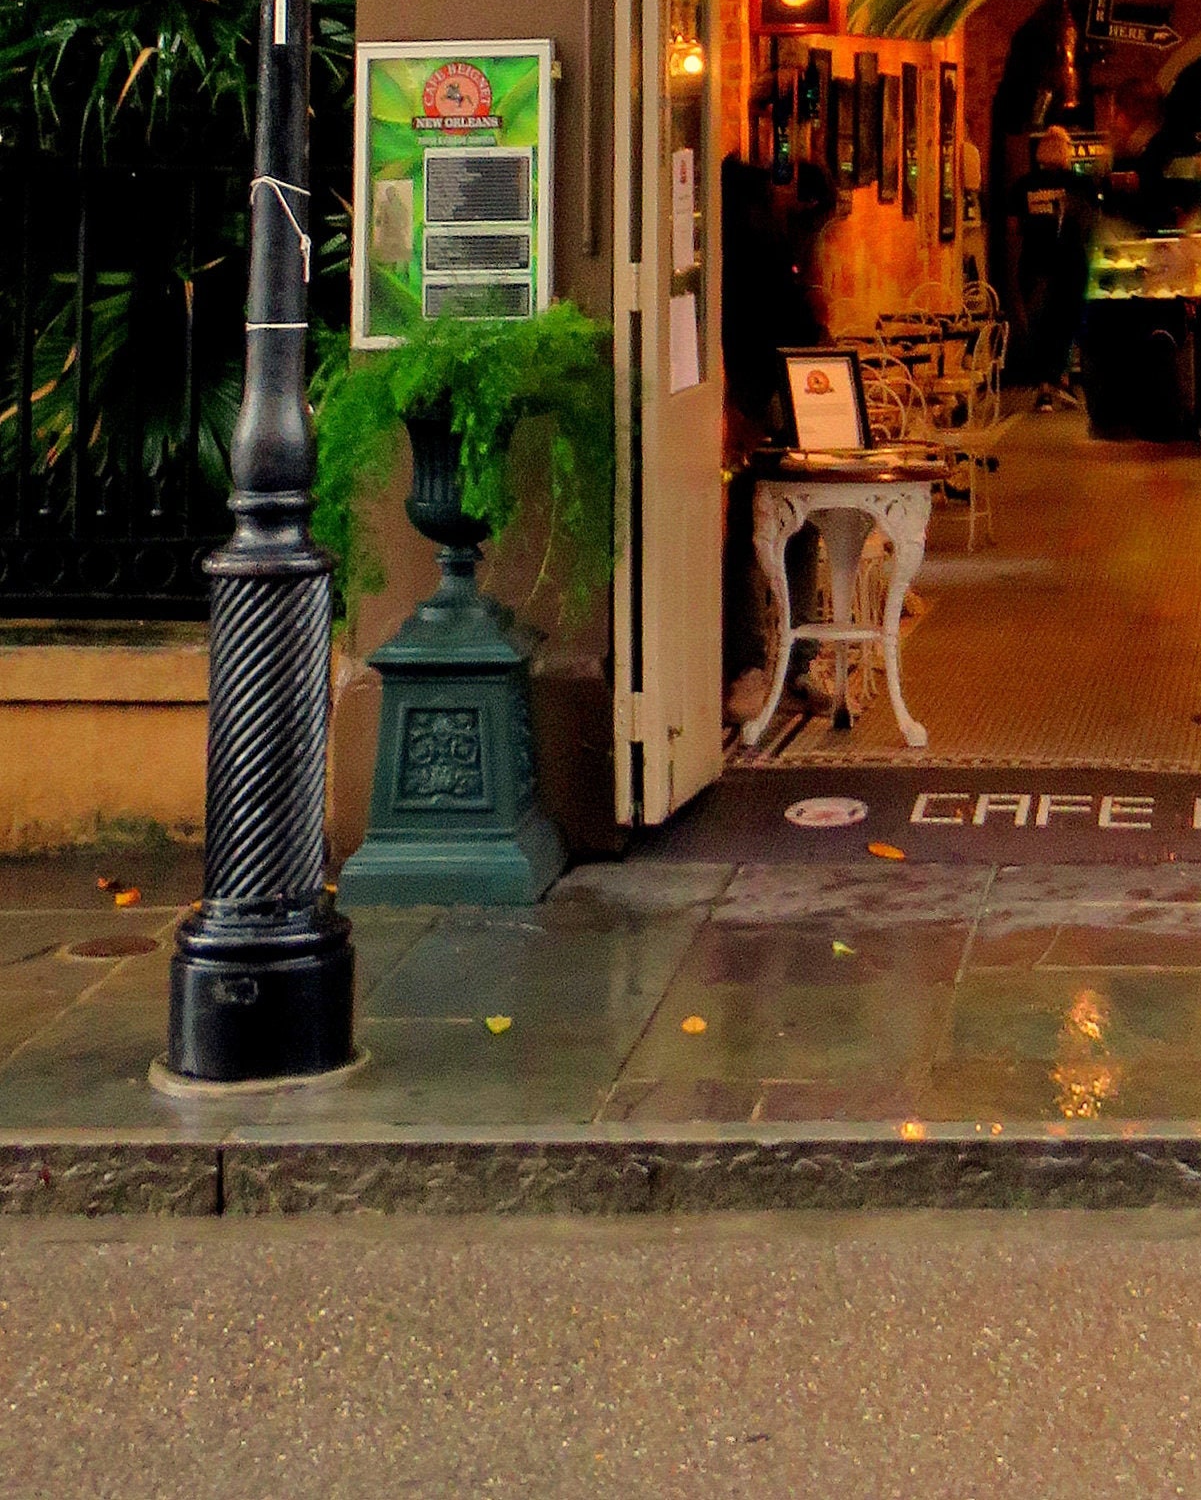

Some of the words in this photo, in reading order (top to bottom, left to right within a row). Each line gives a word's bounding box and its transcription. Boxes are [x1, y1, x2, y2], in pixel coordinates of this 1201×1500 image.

[1108, 25, 1148, 42] HERE
[423, 70, 446, 107] CAFE
[449, 63, 491, 104] BEIGNET
[416, 118, 442, 128] NEW
[445, 116, 499, 128] ORLEANS
[910, 793, 1155, 829] CAFE
